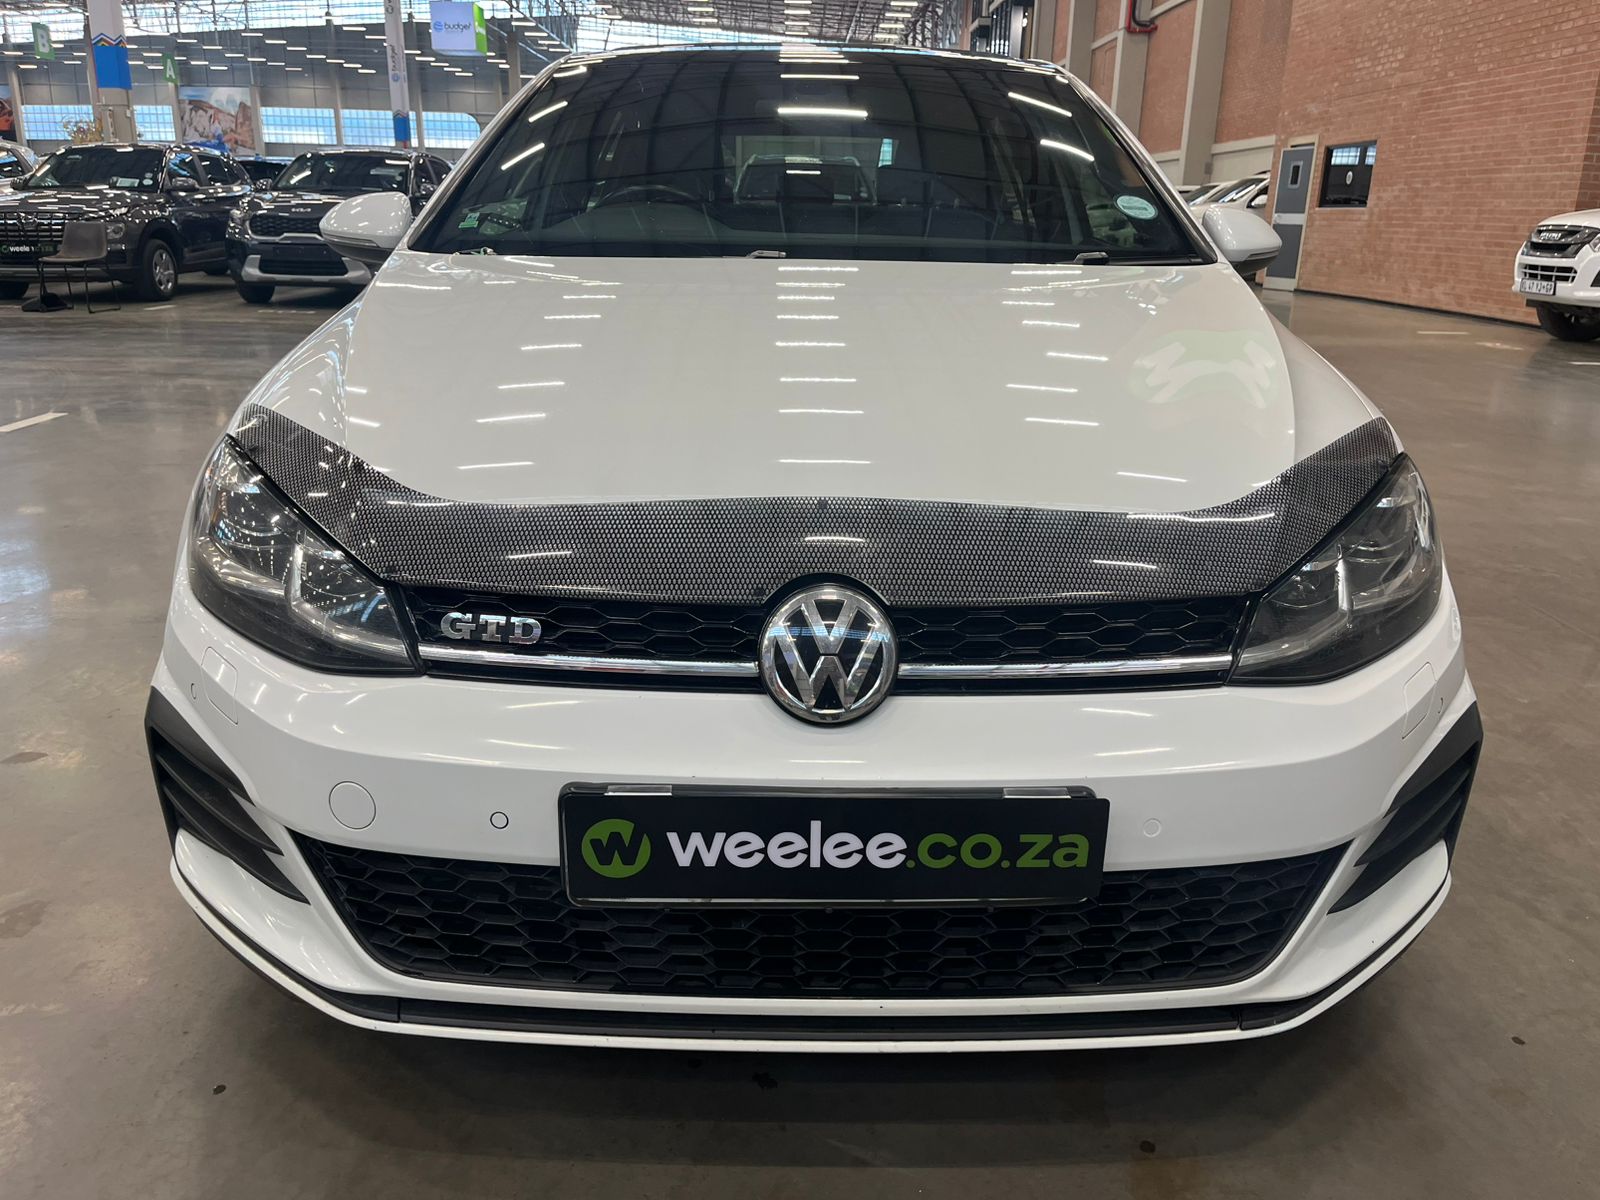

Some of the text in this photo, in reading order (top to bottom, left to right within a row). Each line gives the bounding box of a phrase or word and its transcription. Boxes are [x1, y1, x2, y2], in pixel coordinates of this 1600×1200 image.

[444, 22, 471, 32] budget
[36, 29, 50, 53] B
[166, 59, 176, 79] A
[440, 611, 542, 645] GTD
[666, 820, 1091, 869] weelee.co.za
